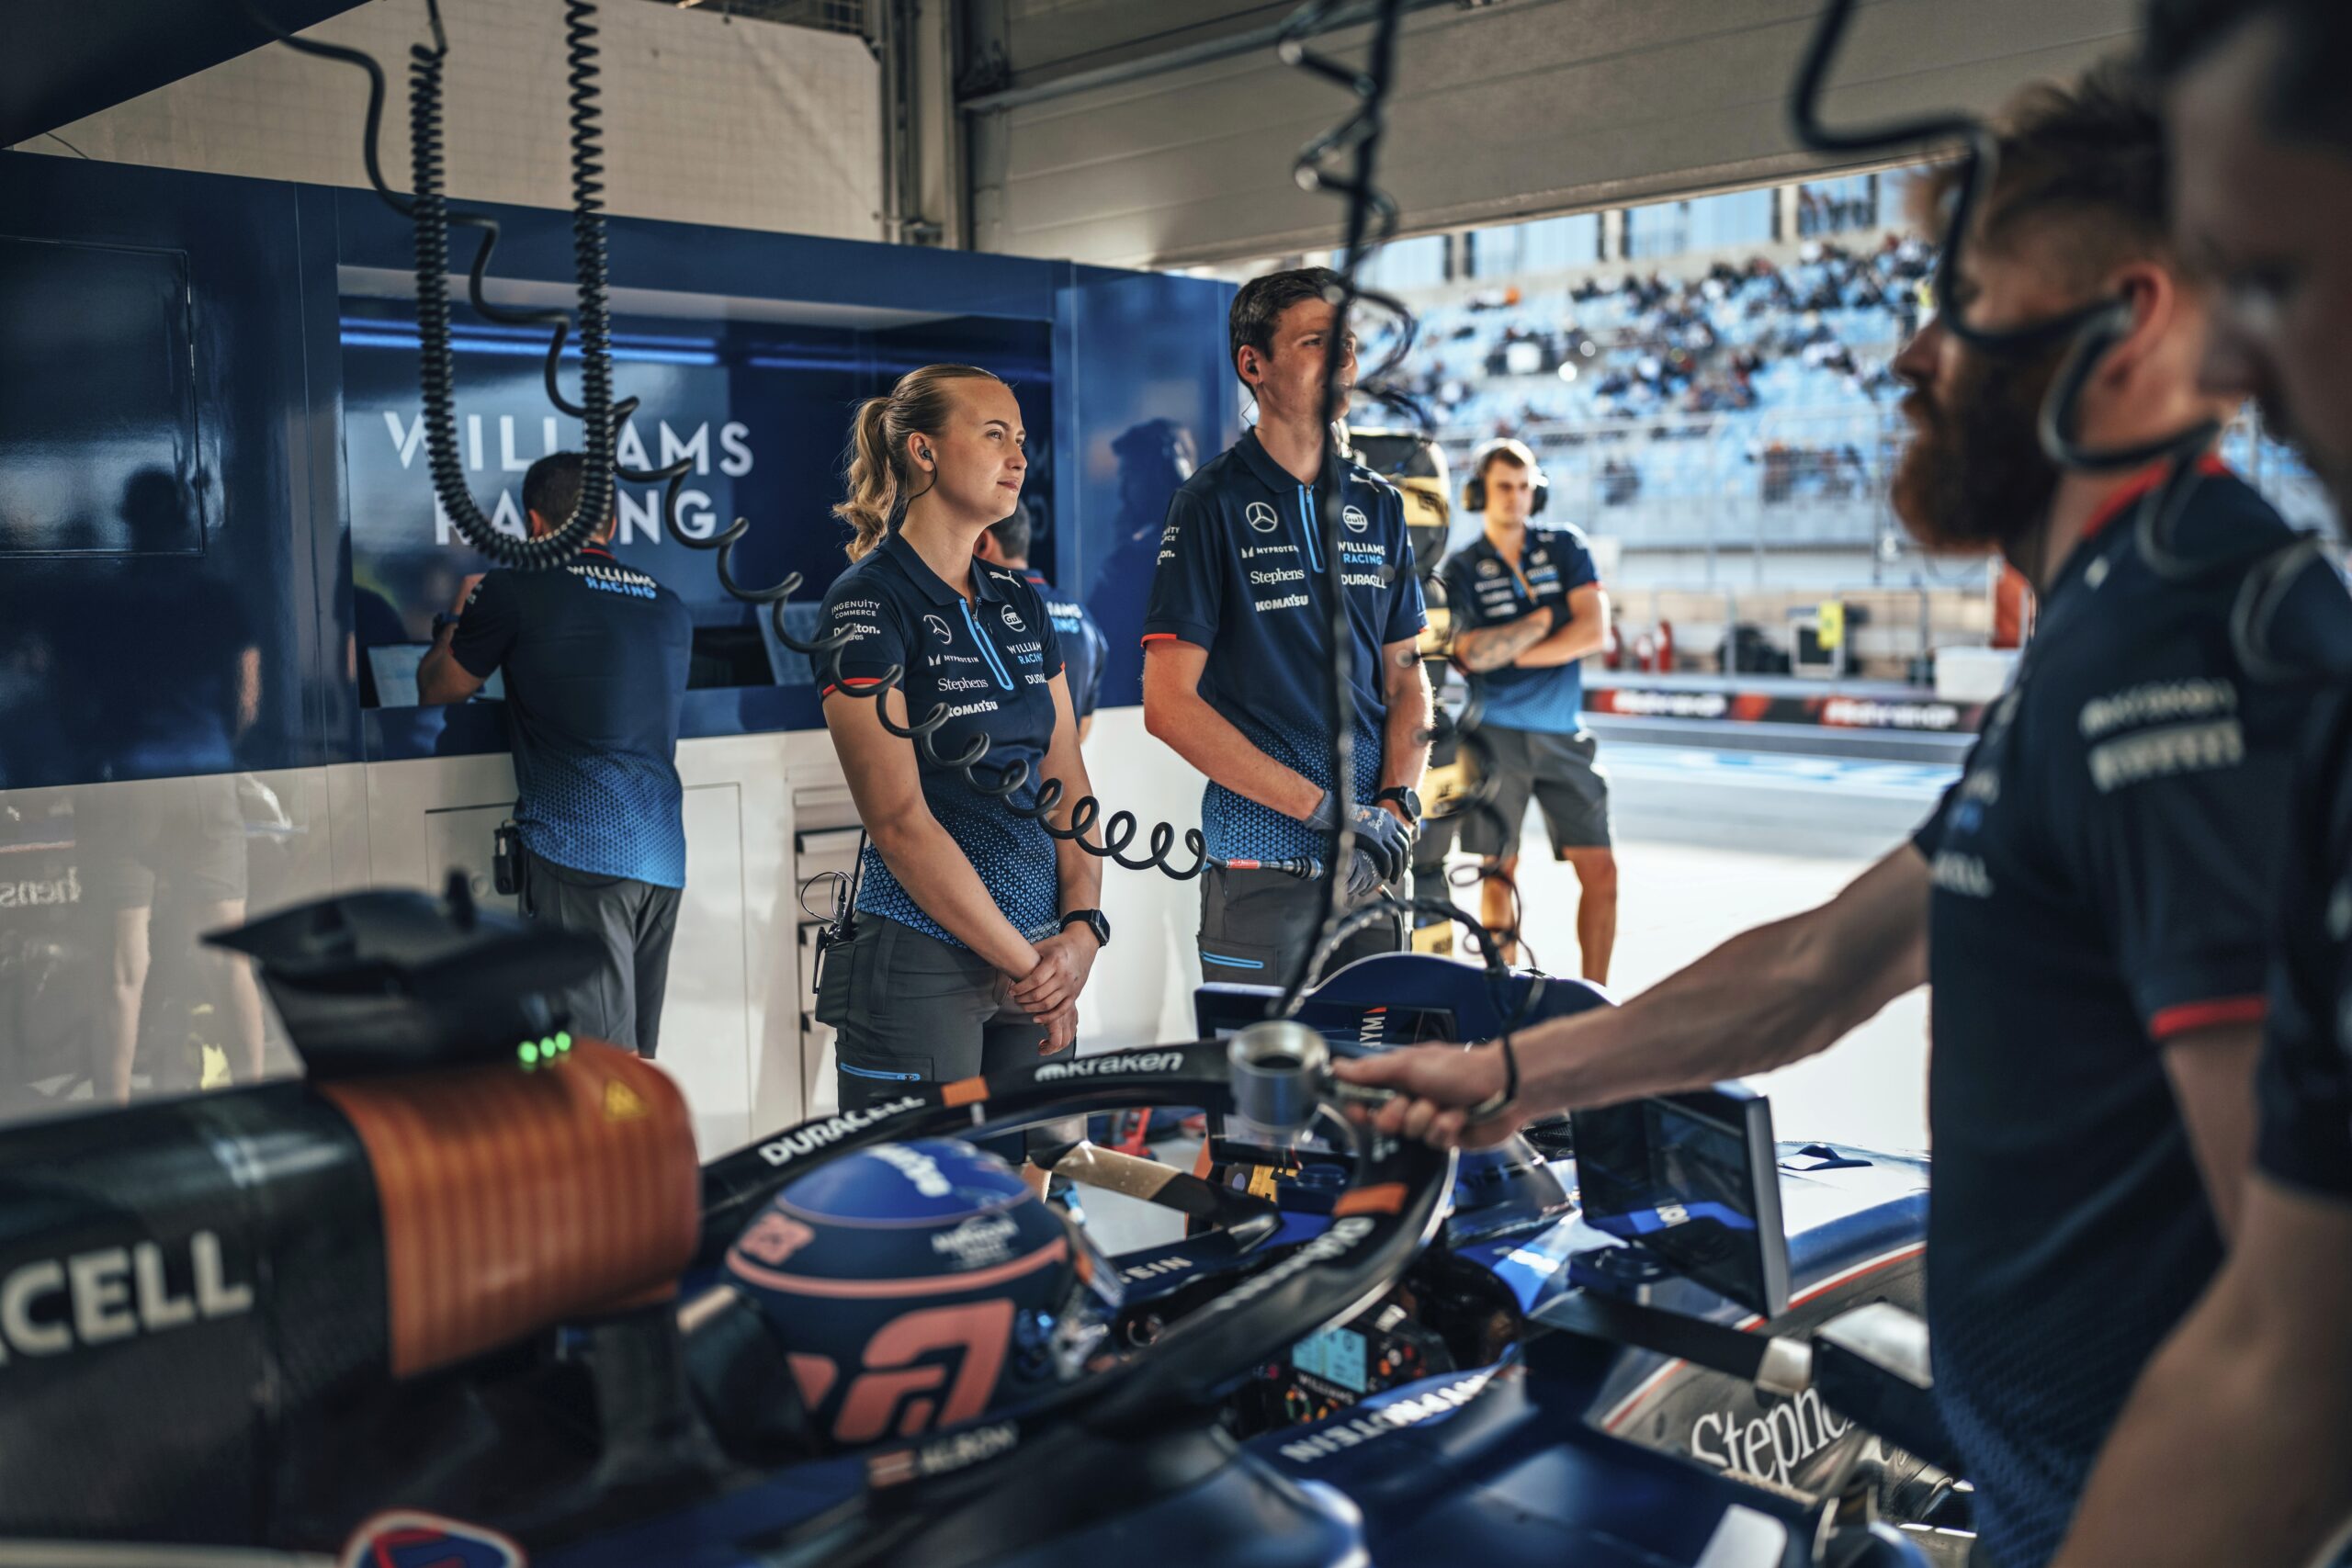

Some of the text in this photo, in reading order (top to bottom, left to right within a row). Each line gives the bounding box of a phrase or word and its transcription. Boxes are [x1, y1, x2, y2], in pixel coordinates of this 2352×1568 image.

[384, 412, 754, 477] WILAMS
[1256, 545, 1299, 554] MYPROTE
[1338, 541, 1385, 556] WILLIAMS
[1343, 553, 1383, 566] RACING
[1250, 568, 1305, 584] Stephens
[1255, 593, 1308, 612] KOMATSU
[834, 609, 876, 619] COMMERCE
[1006, 641, 1042, 654] WILLIAM
[944, 655, 979, 663] MYPROTEIN
[1017, 652, 1044, 664] RACIN
[937, 677, 989, 692] Stephens
[758, 1096, 926, 1167] DURACELL
[0, 1229, 254, 1365] CELL
